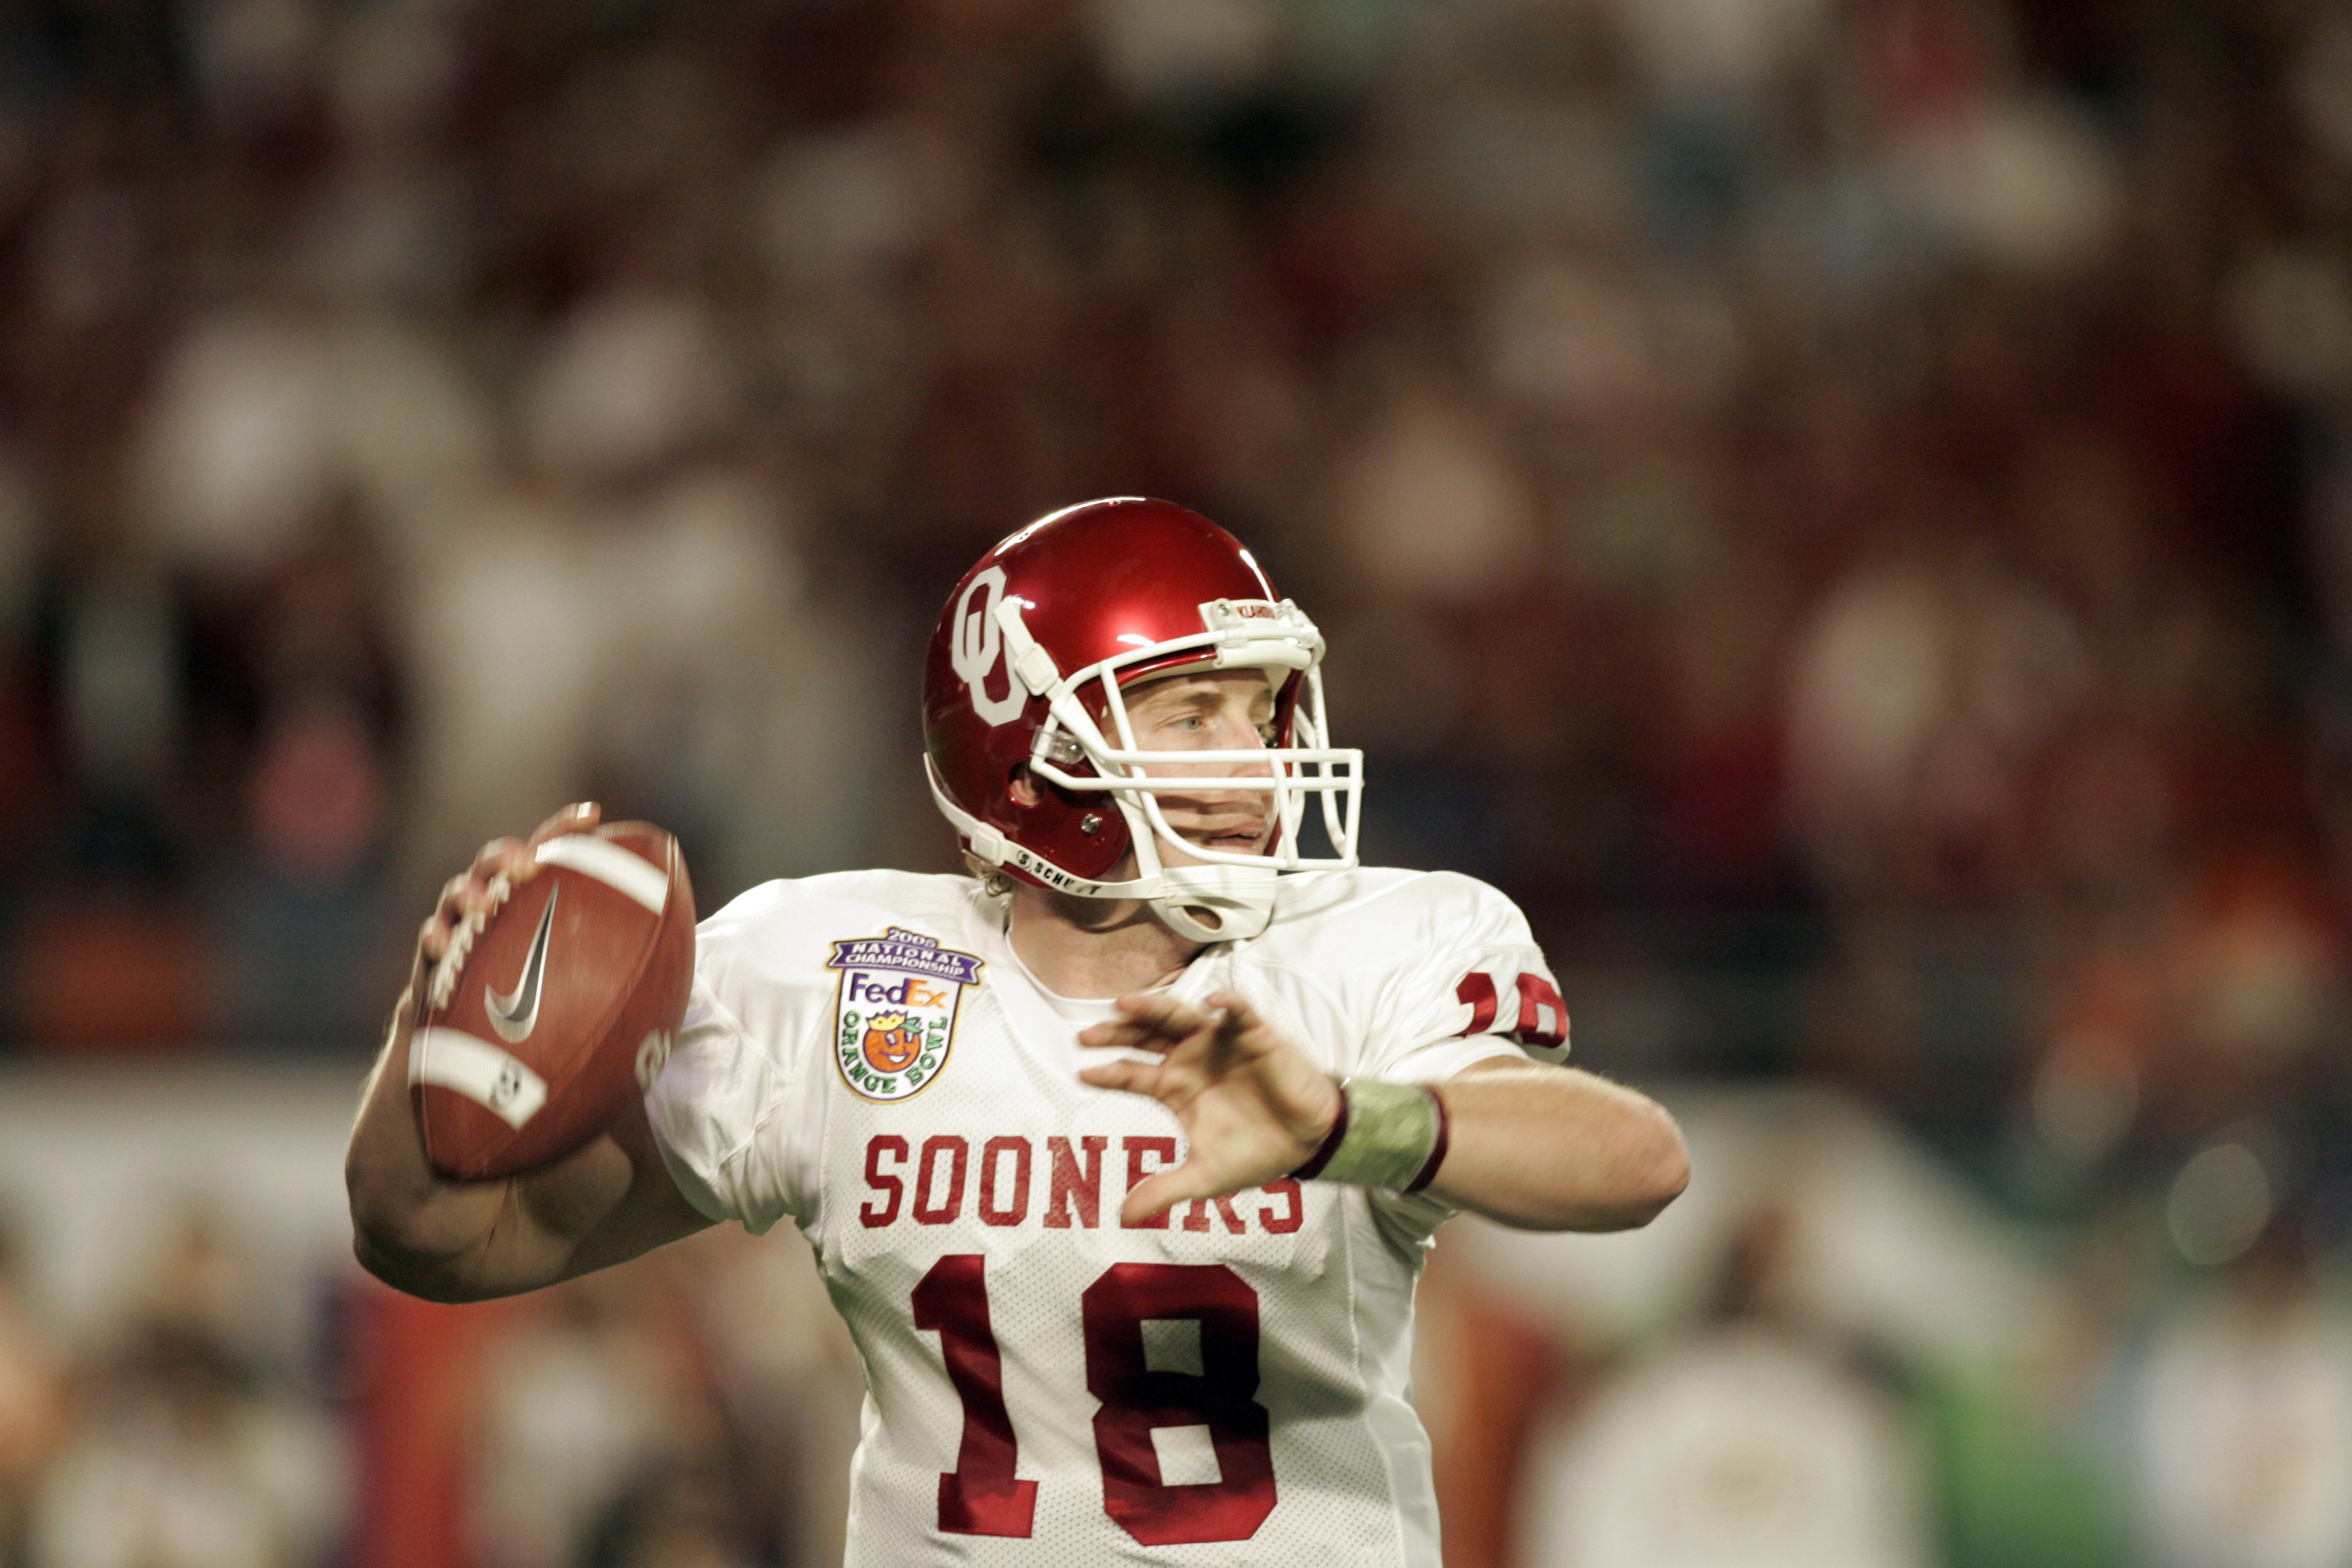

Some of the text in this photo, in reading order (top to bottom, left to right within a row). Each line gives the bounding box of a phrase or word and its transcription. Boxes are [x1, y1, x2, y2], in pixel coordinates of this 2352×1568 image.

[1034, 862, 1101, 895] SCHUT
[851, 943, 962, 967] NATIONAL
[889, 929, 936, 948] 2005
[845, 953, 965, 976] CHAMPIONSHIP
[849, 973, 948, 1008] FedEx
[842, 1010, 948, 1093] ORANGE BOWL
[911, 1254, 1277, 1547] 18
